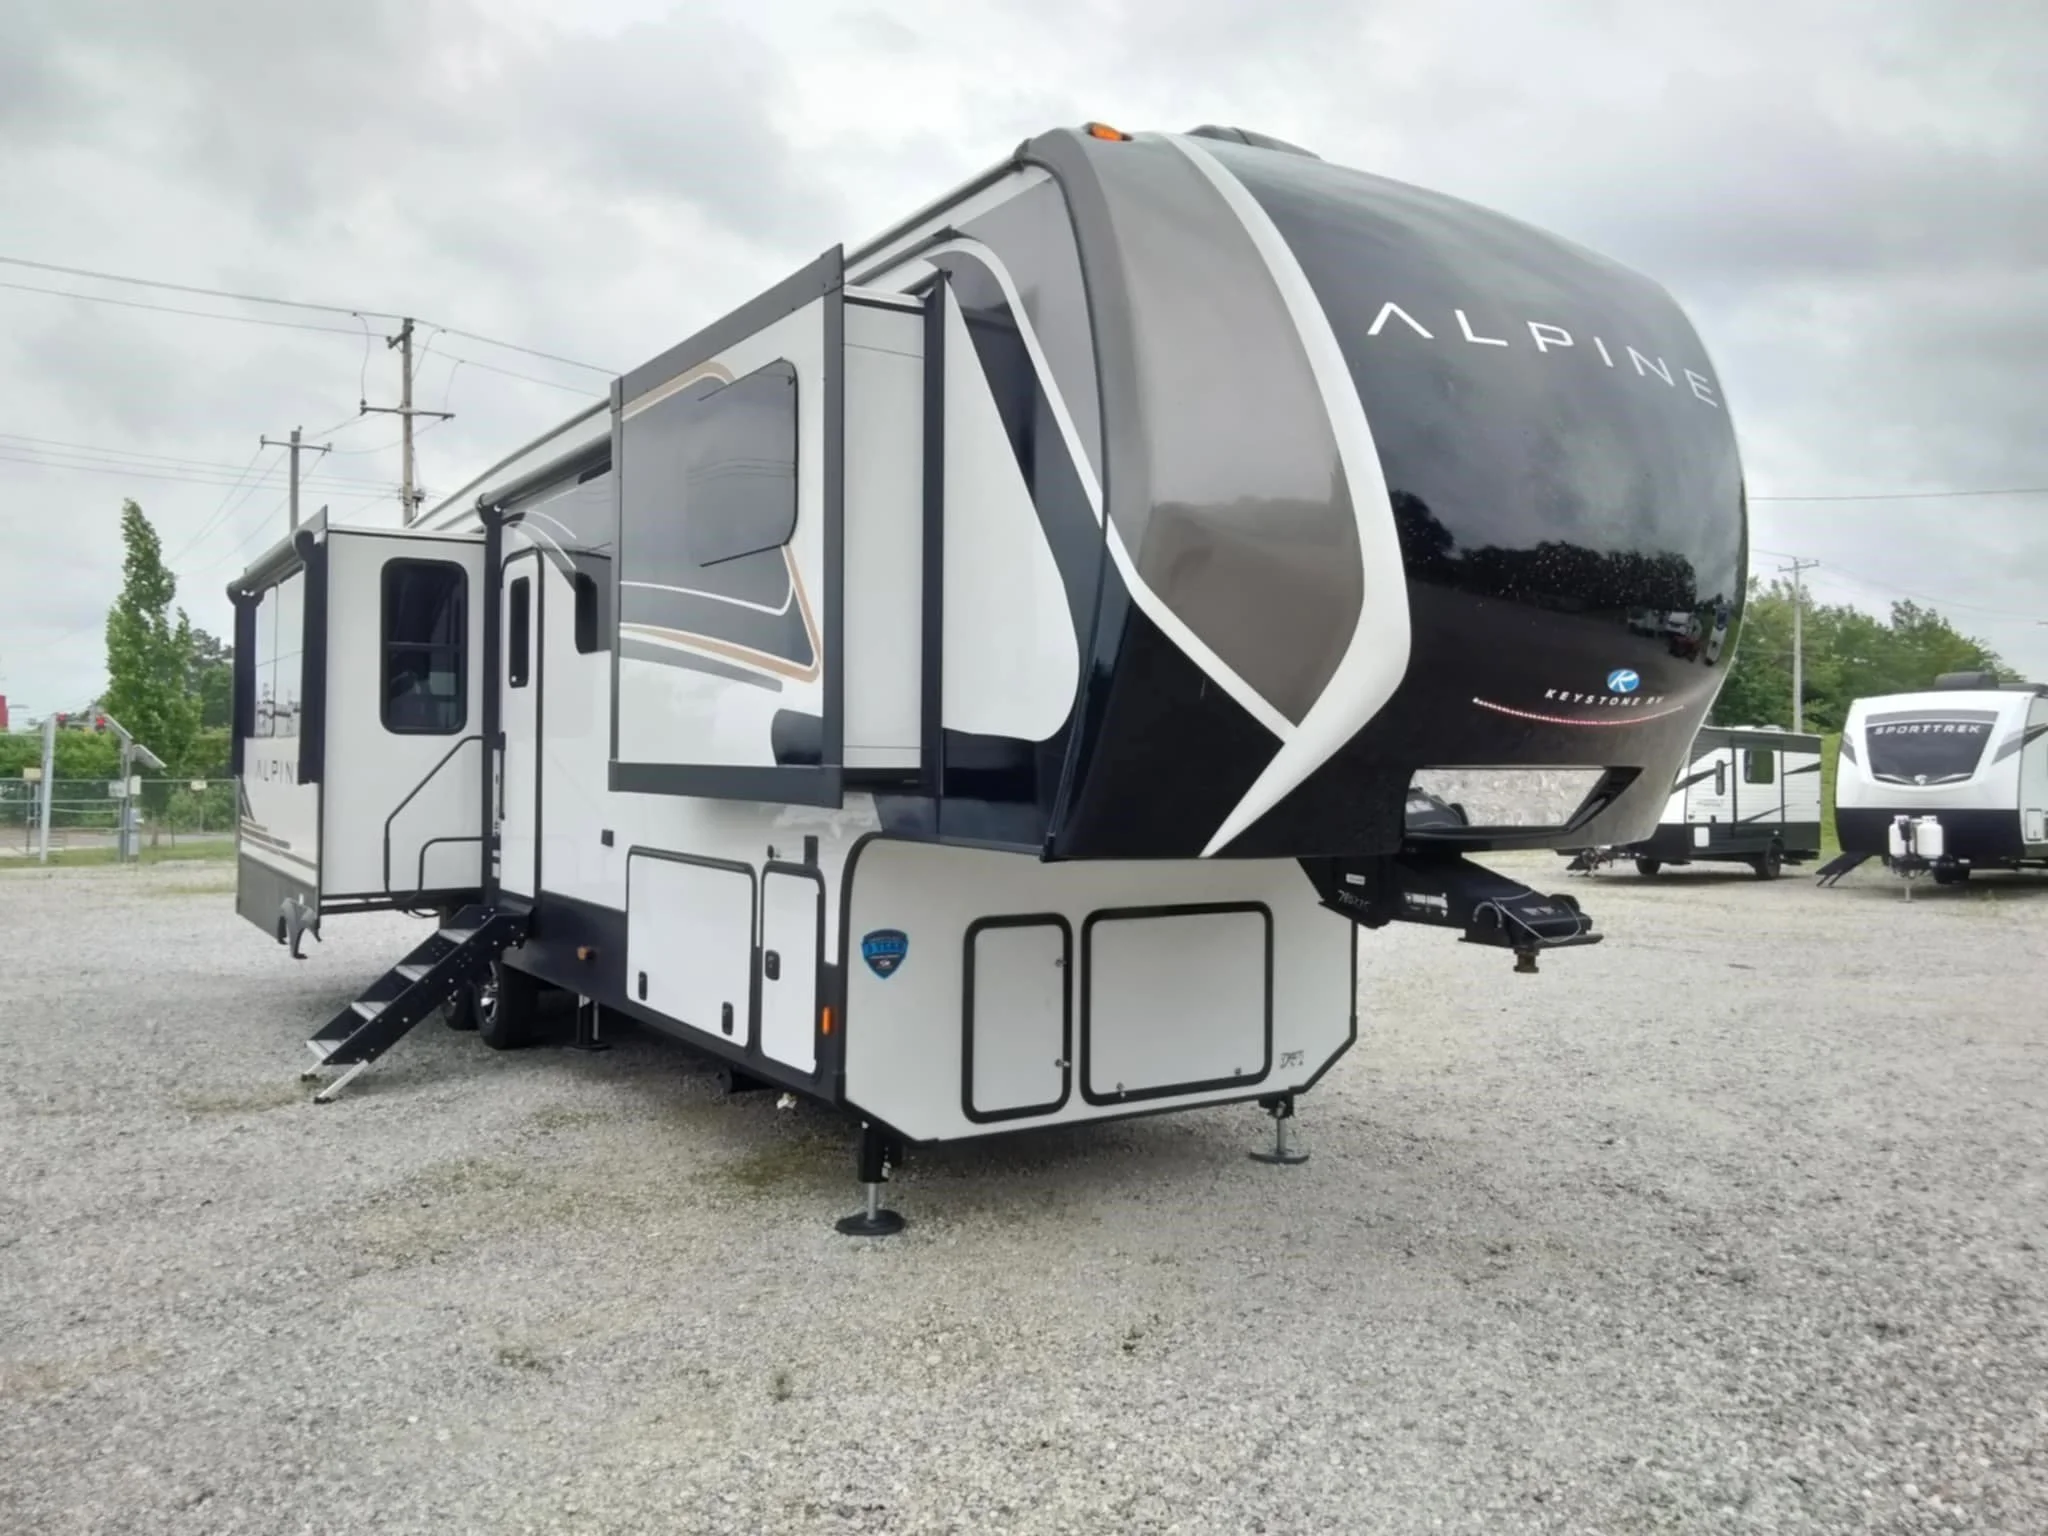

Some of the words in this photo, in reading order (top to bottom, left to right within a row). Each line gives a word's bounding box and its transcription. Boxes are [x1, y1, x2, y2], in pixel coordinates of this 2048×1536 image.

[1367, 301, 1719, 408] ALPINE
[1545, 689, 1640, 706] KEYSTONE
[1874, 724, 1981, 735] SPORTTREK
[256, 759, 299, 784] ALPIN
